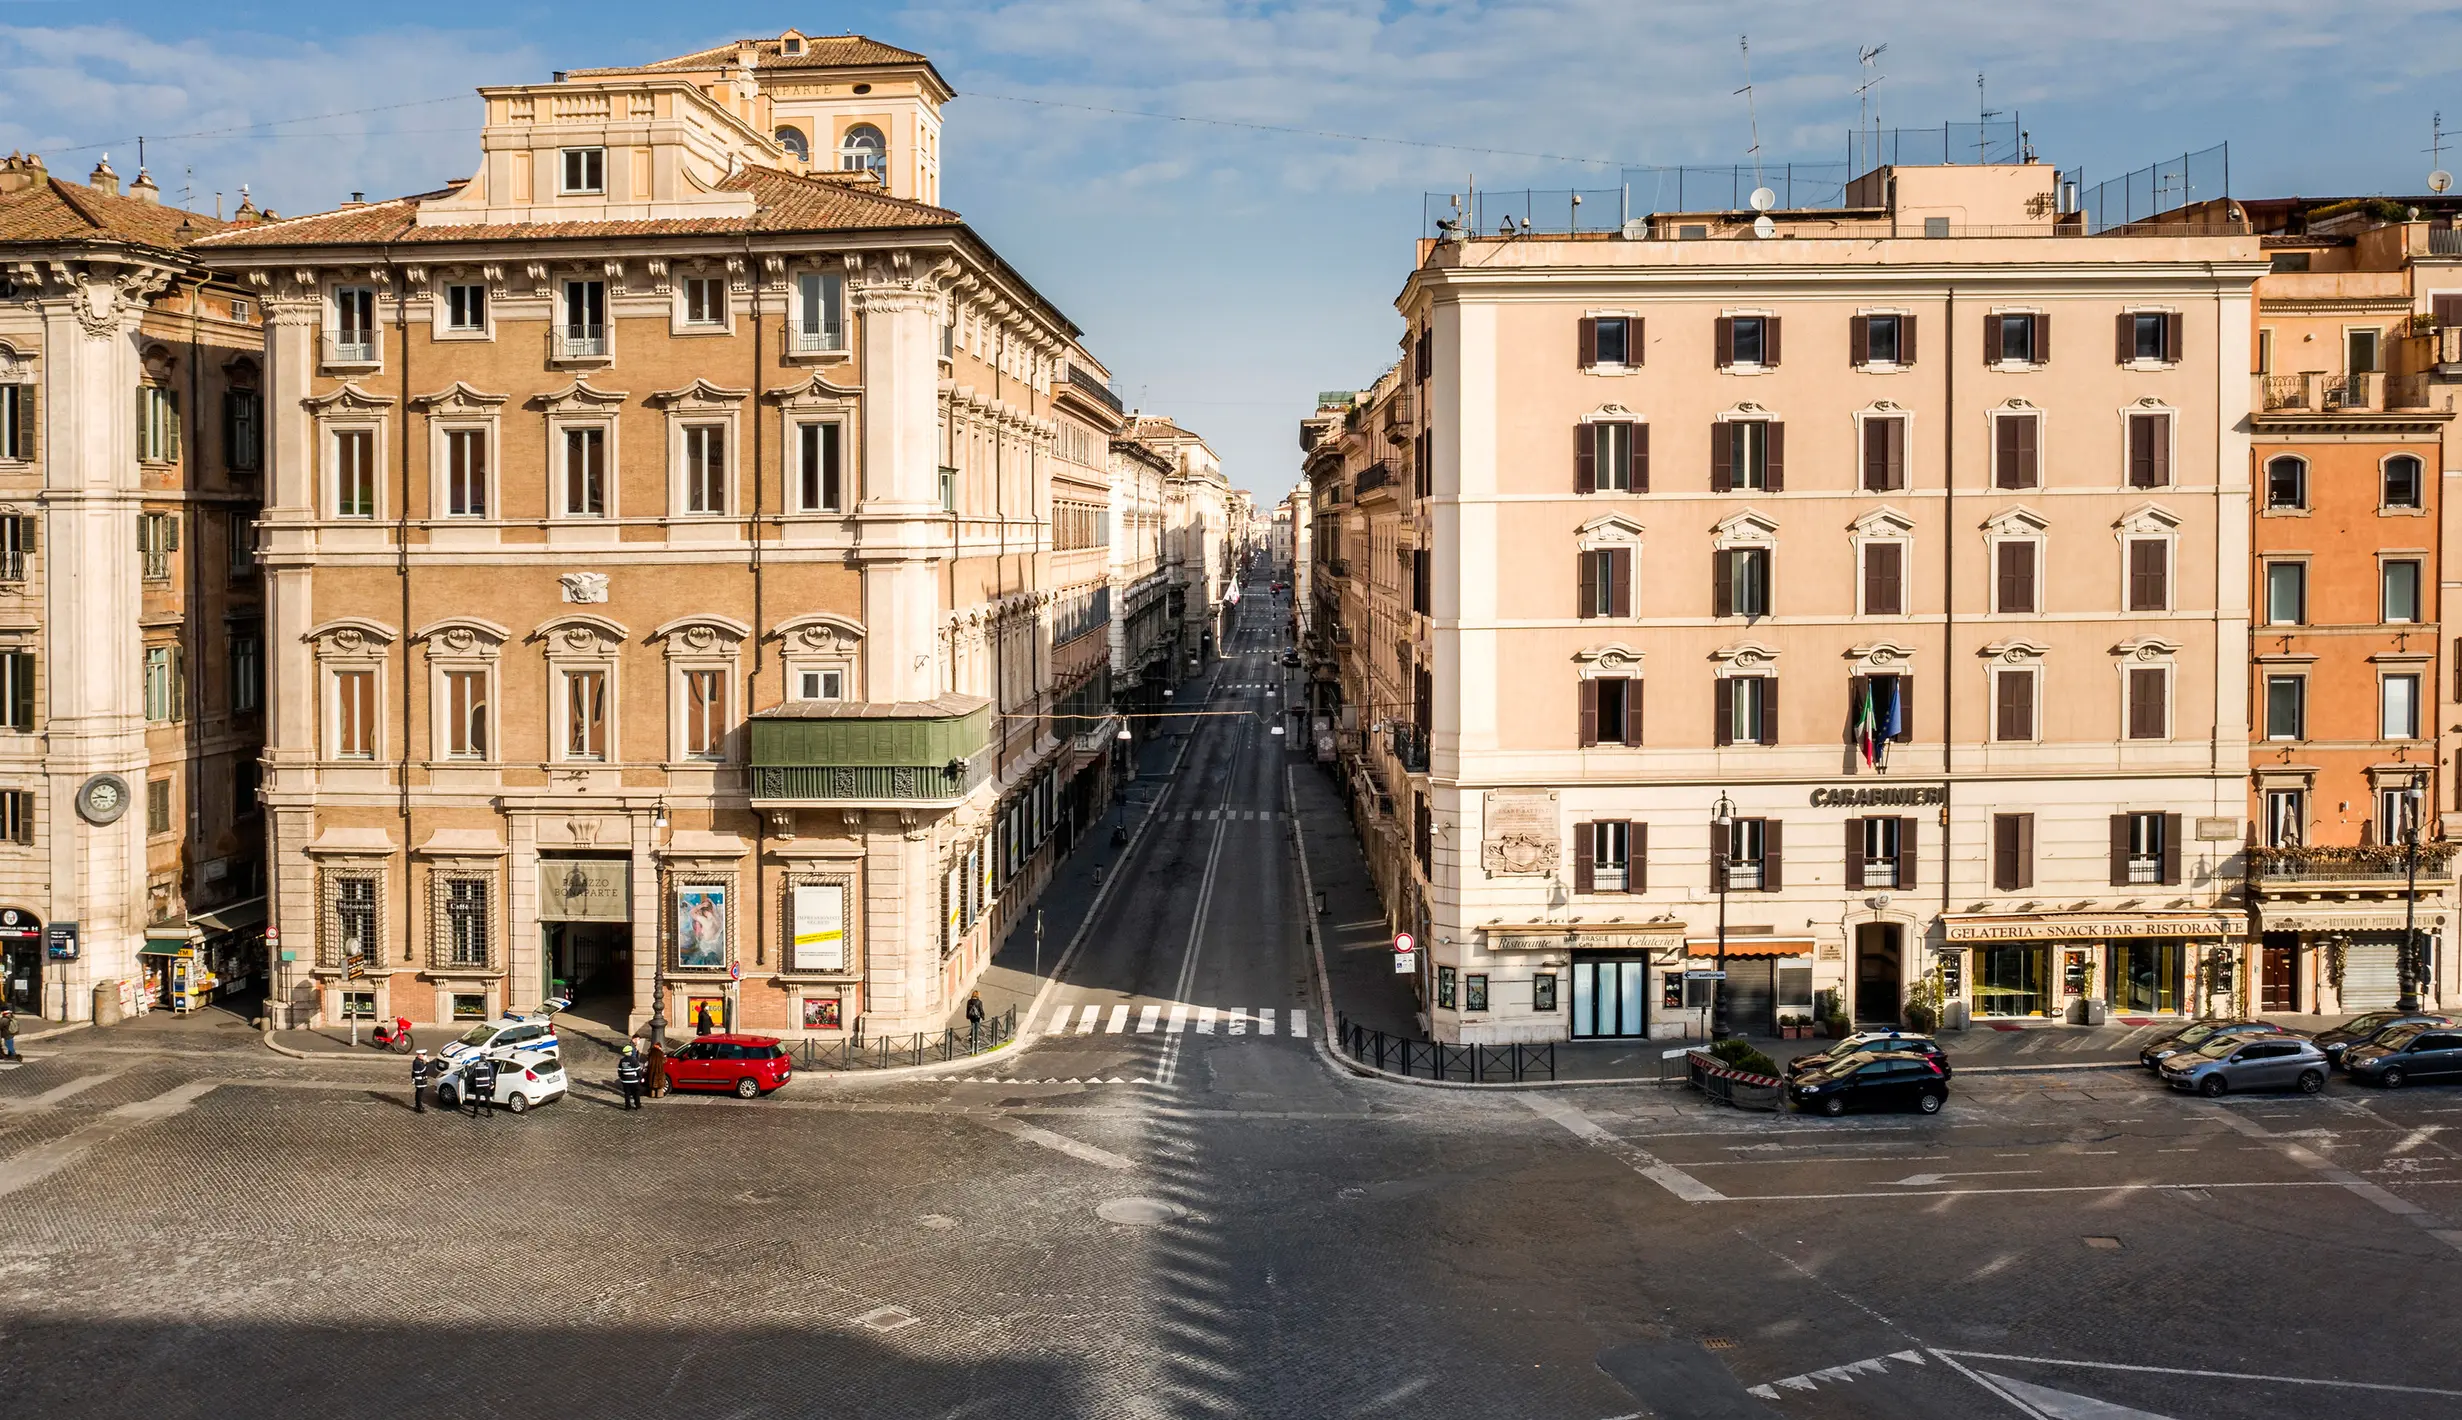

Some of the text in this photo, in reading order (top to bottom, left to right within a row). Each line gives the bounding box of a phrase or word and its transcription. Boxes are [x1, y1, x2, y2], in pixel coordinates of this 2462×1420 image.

[760, 84, 832, 96] NAPARTE
[1811, 786, 1946, 807] CARABINIERI
[563, 879, 610, 888] PALAZZO
[554, 888, 618, 897] BONAPARTE
[2329, 917, 2368, 927] RESTAURANT
[2372, 917, 2401, 927] PIZZERIA
[1951, 922, 2244, 939] GELATERIA SNACK BAR RISTORANTE
[1498, 937, 1552, 949] Ristorante
[1627, 935, 1675, 947] Gelateria
